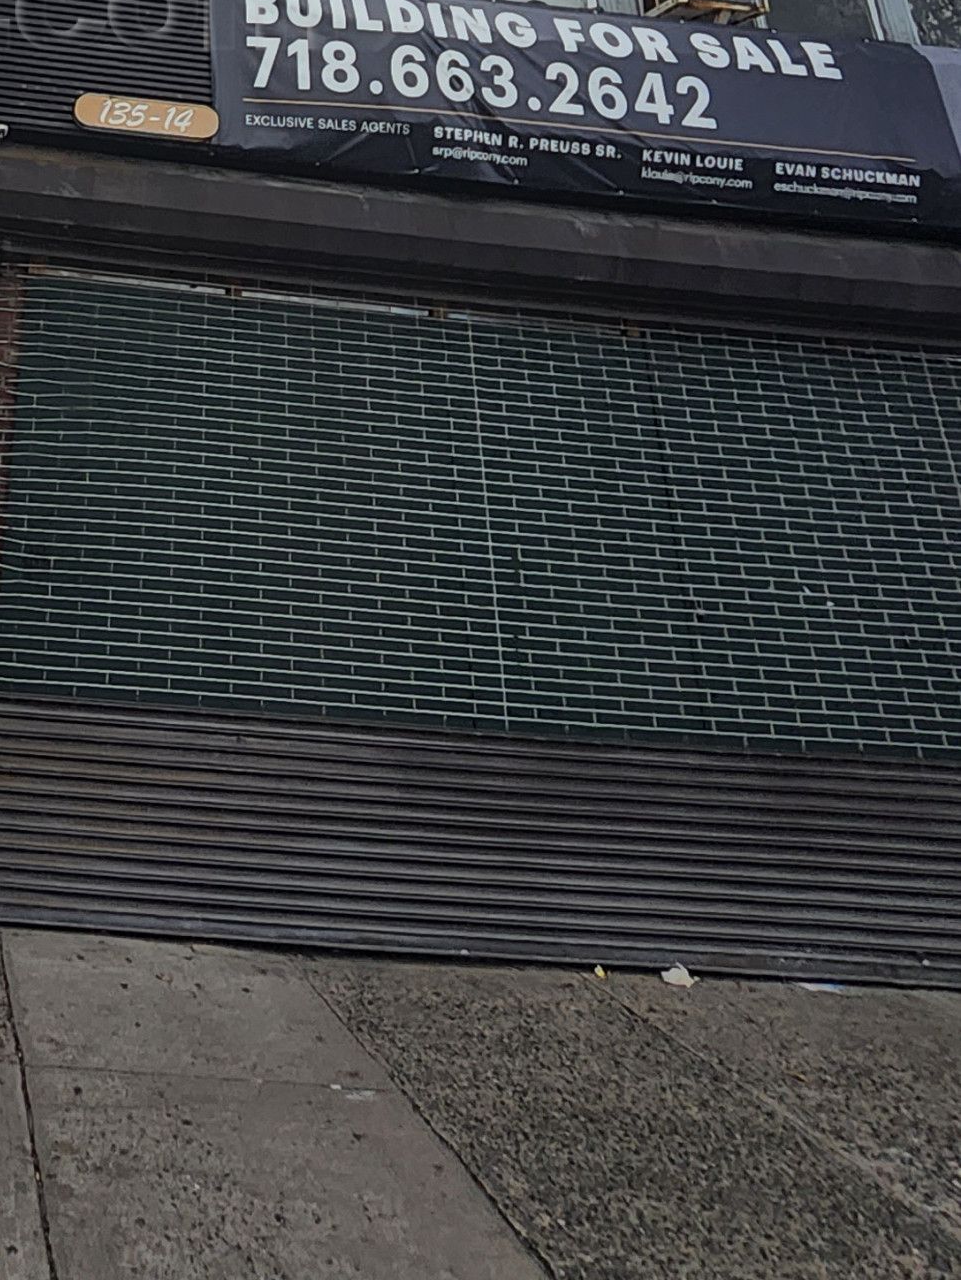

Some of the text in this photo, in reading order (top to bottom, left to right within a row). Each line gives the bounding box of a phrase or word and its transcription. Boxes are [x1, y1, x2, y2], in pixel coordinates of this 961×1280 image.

[553, 18, 678, 64] FOR
[690, 32, 843, 80] SALE
[245, 36, 717, 130] 718.663.2642
[100, 99, 194, 132] 135-14
[245, 114, 411, 135] EXCLUSIVE SALES AGENTS
[434, 126, 622, 159] STEPHEN R. PREUSS SR.
[642, 149, 744, 171] KEVIN LOUIE
[775, 162, 921, 187] EVAN SCHUCKMAN
